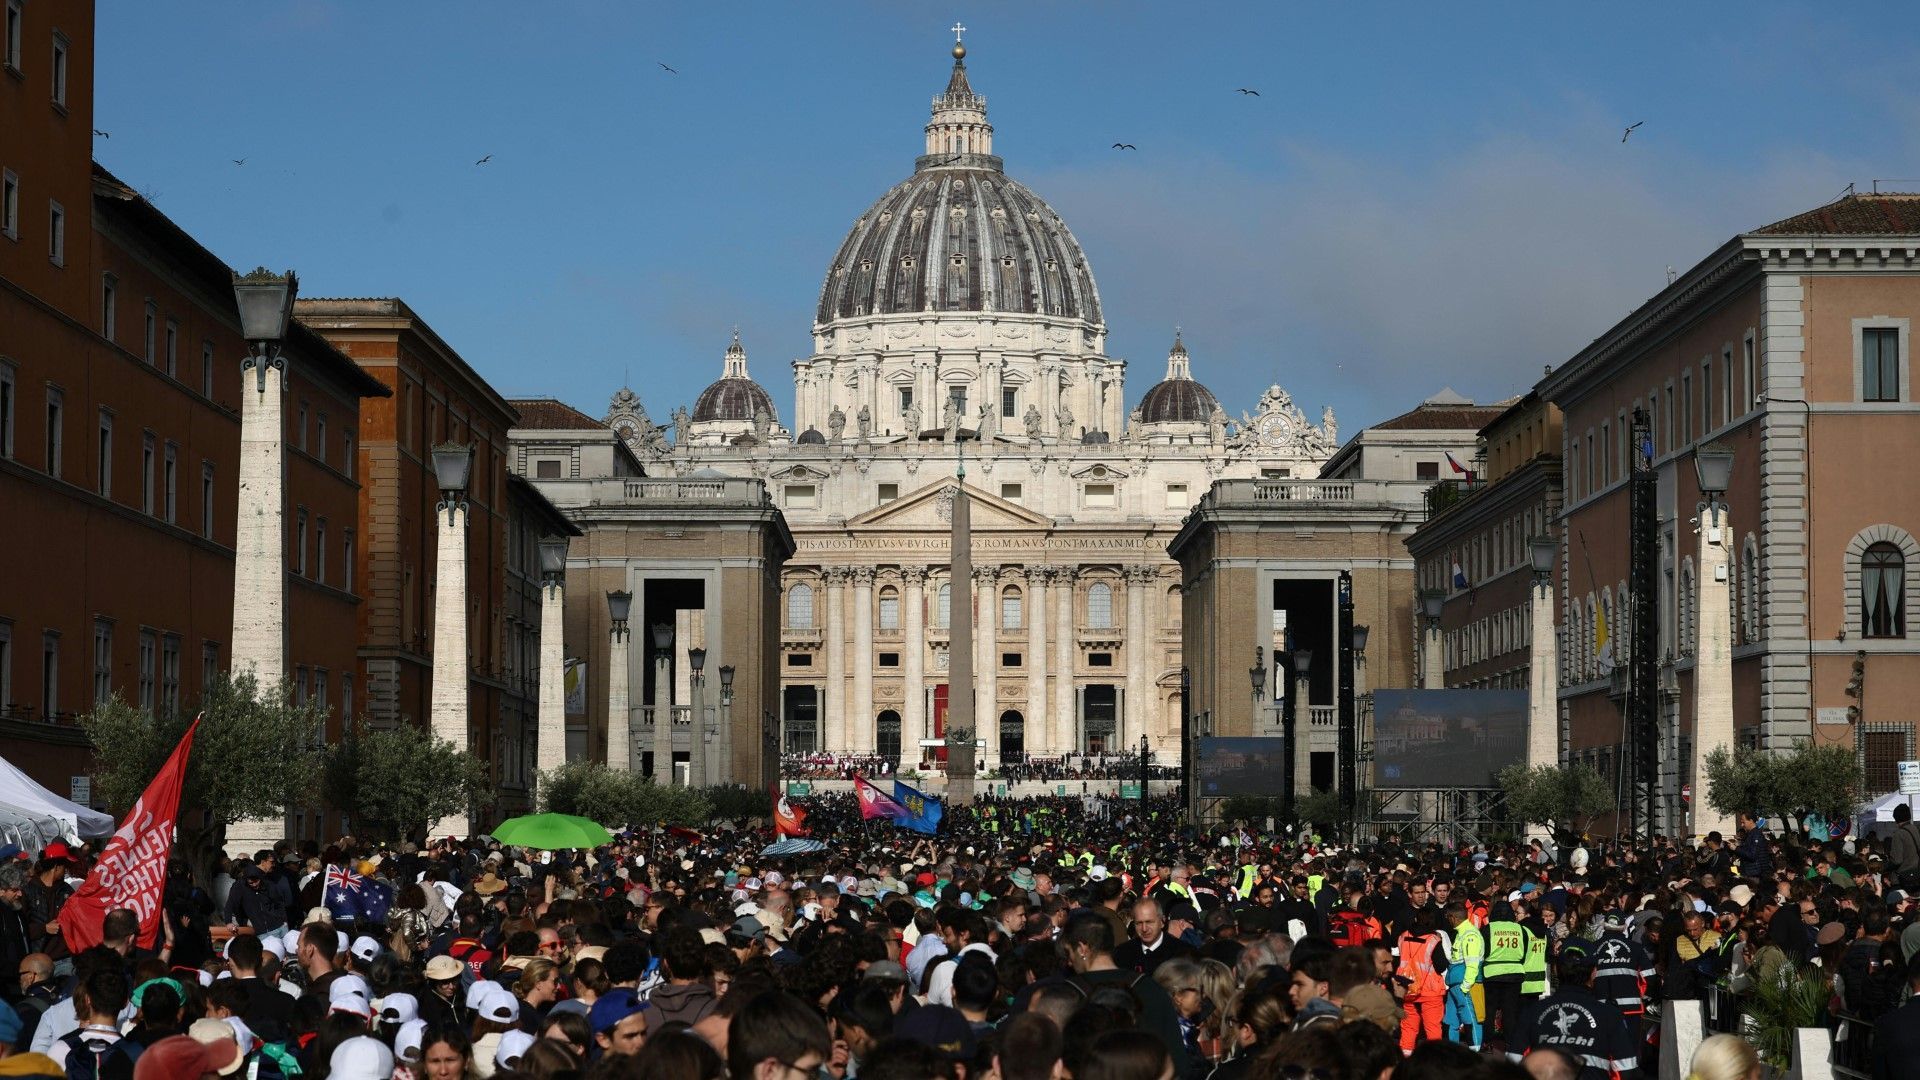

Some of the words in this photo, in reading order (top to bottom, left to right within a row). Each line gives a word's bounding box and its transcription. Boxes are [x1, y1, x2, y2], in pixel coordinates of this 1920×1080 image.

[855, 539, 896, 548] PAVLVS
[984, 539, 1045, 548] ROMANVS
[1048, 539, 1078, 548] PONT
[1496, 937, 1518, 949] 418
[1561, 1002, 1597, 1029] INTERVENTO
